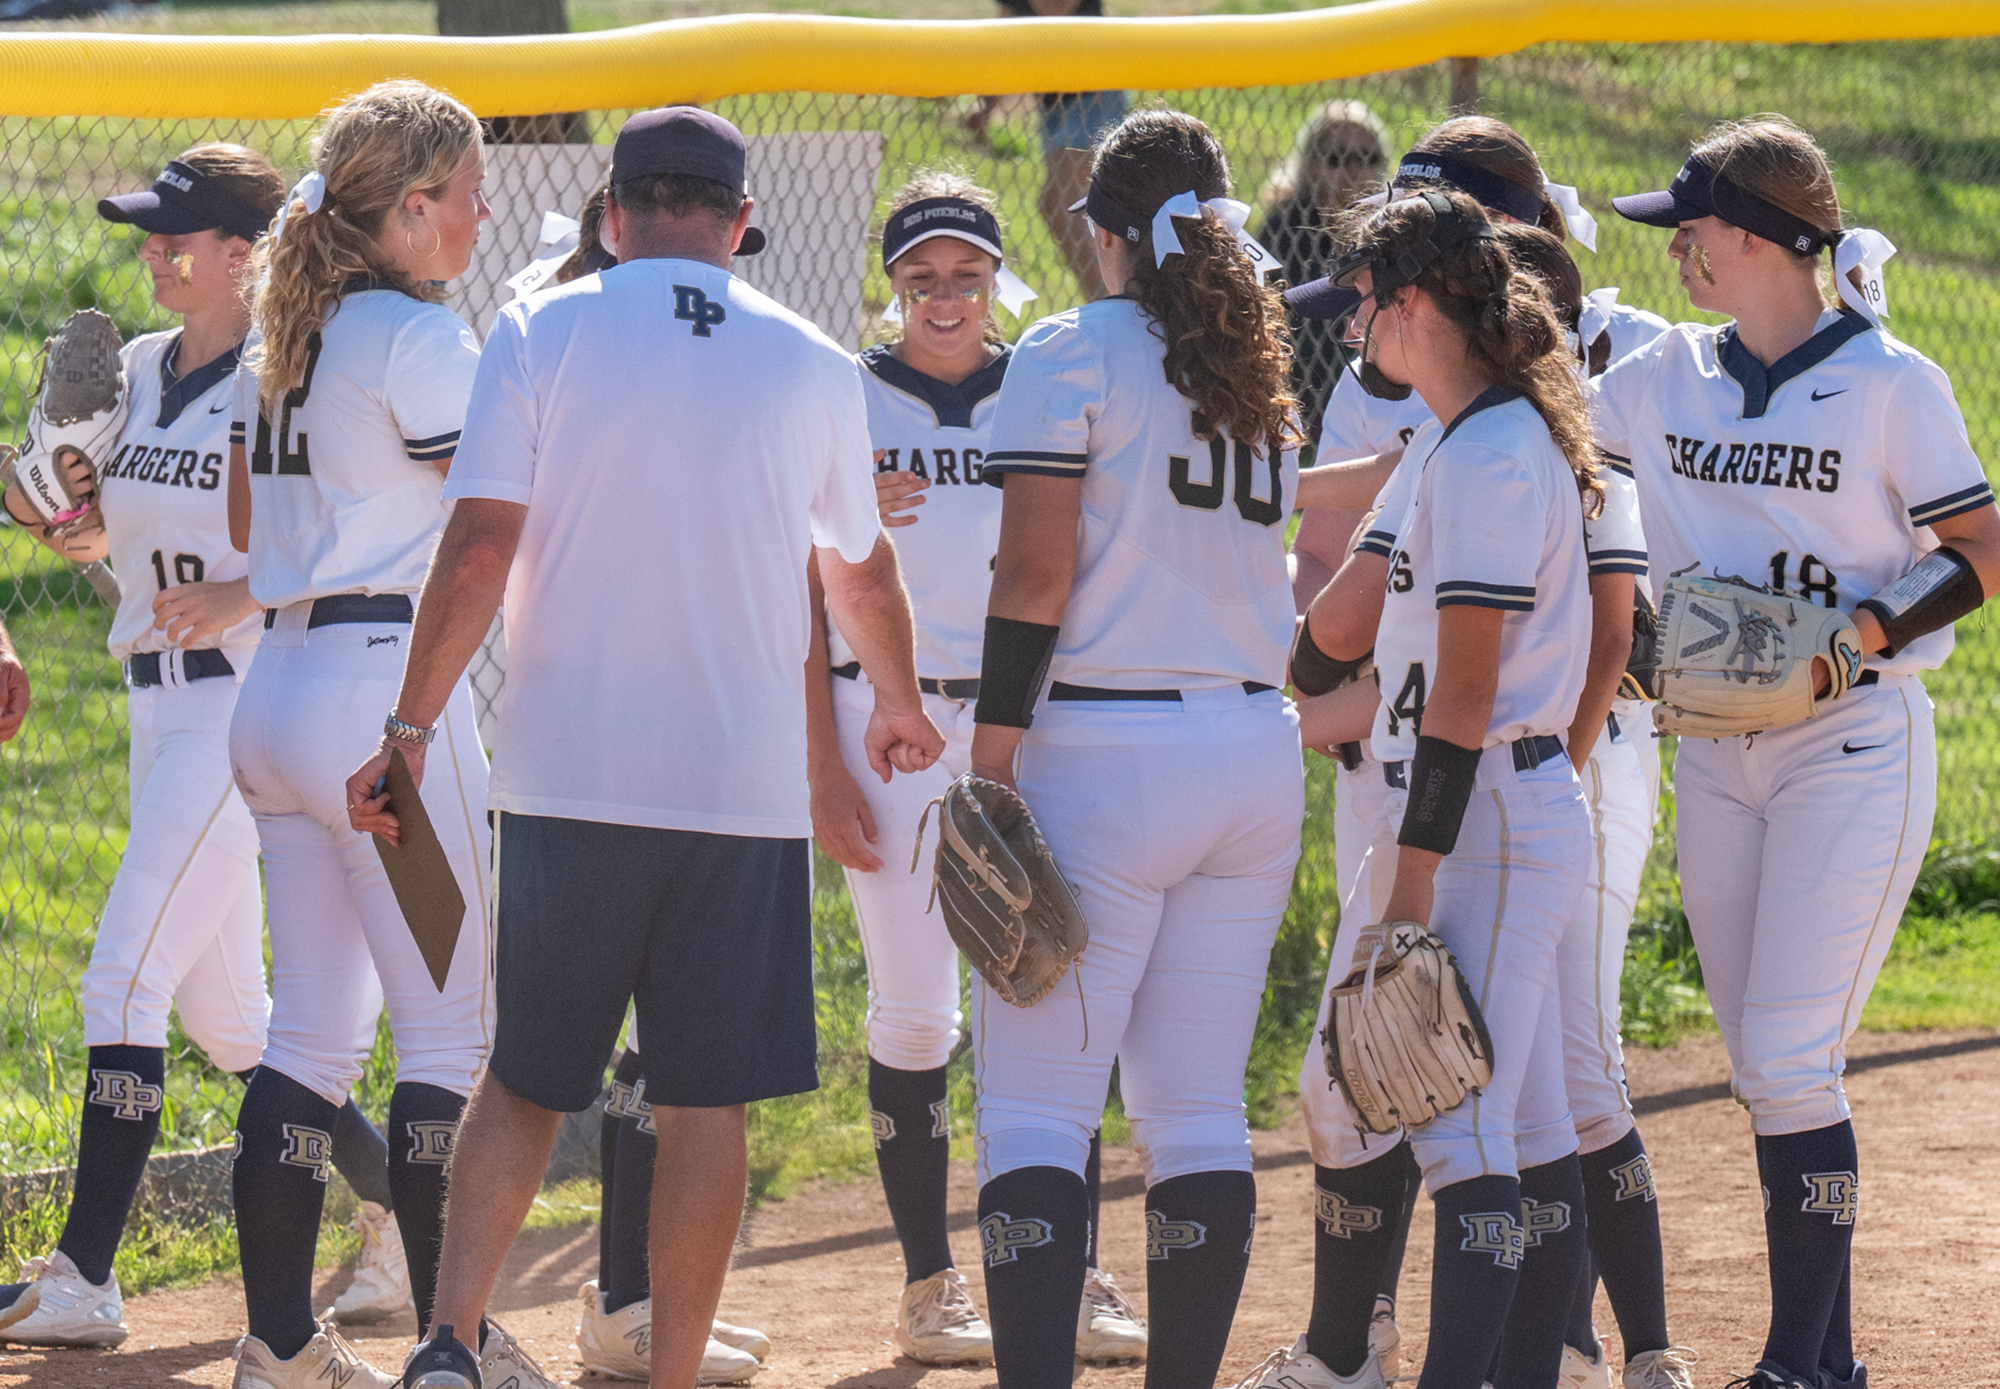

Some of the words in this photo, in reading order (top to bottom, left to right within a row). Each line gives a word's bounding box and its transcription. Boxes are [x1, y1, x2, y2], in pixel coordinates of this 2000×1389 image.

[903, 211, 923, 229] DOS
[924, 207, 977, 222] PUEBLOS
[673, 284, 726, 338] DP
[1863, 279, 1880, 305] 18
[104, 443, 223, 491] ARGERS
[1665, 433, 1842, 493] CHARGERS
[29, 464, 61, 514] Wilson
[1768, 550, 1839, 609] 18
[89, 1069, 162, 1121] DP
